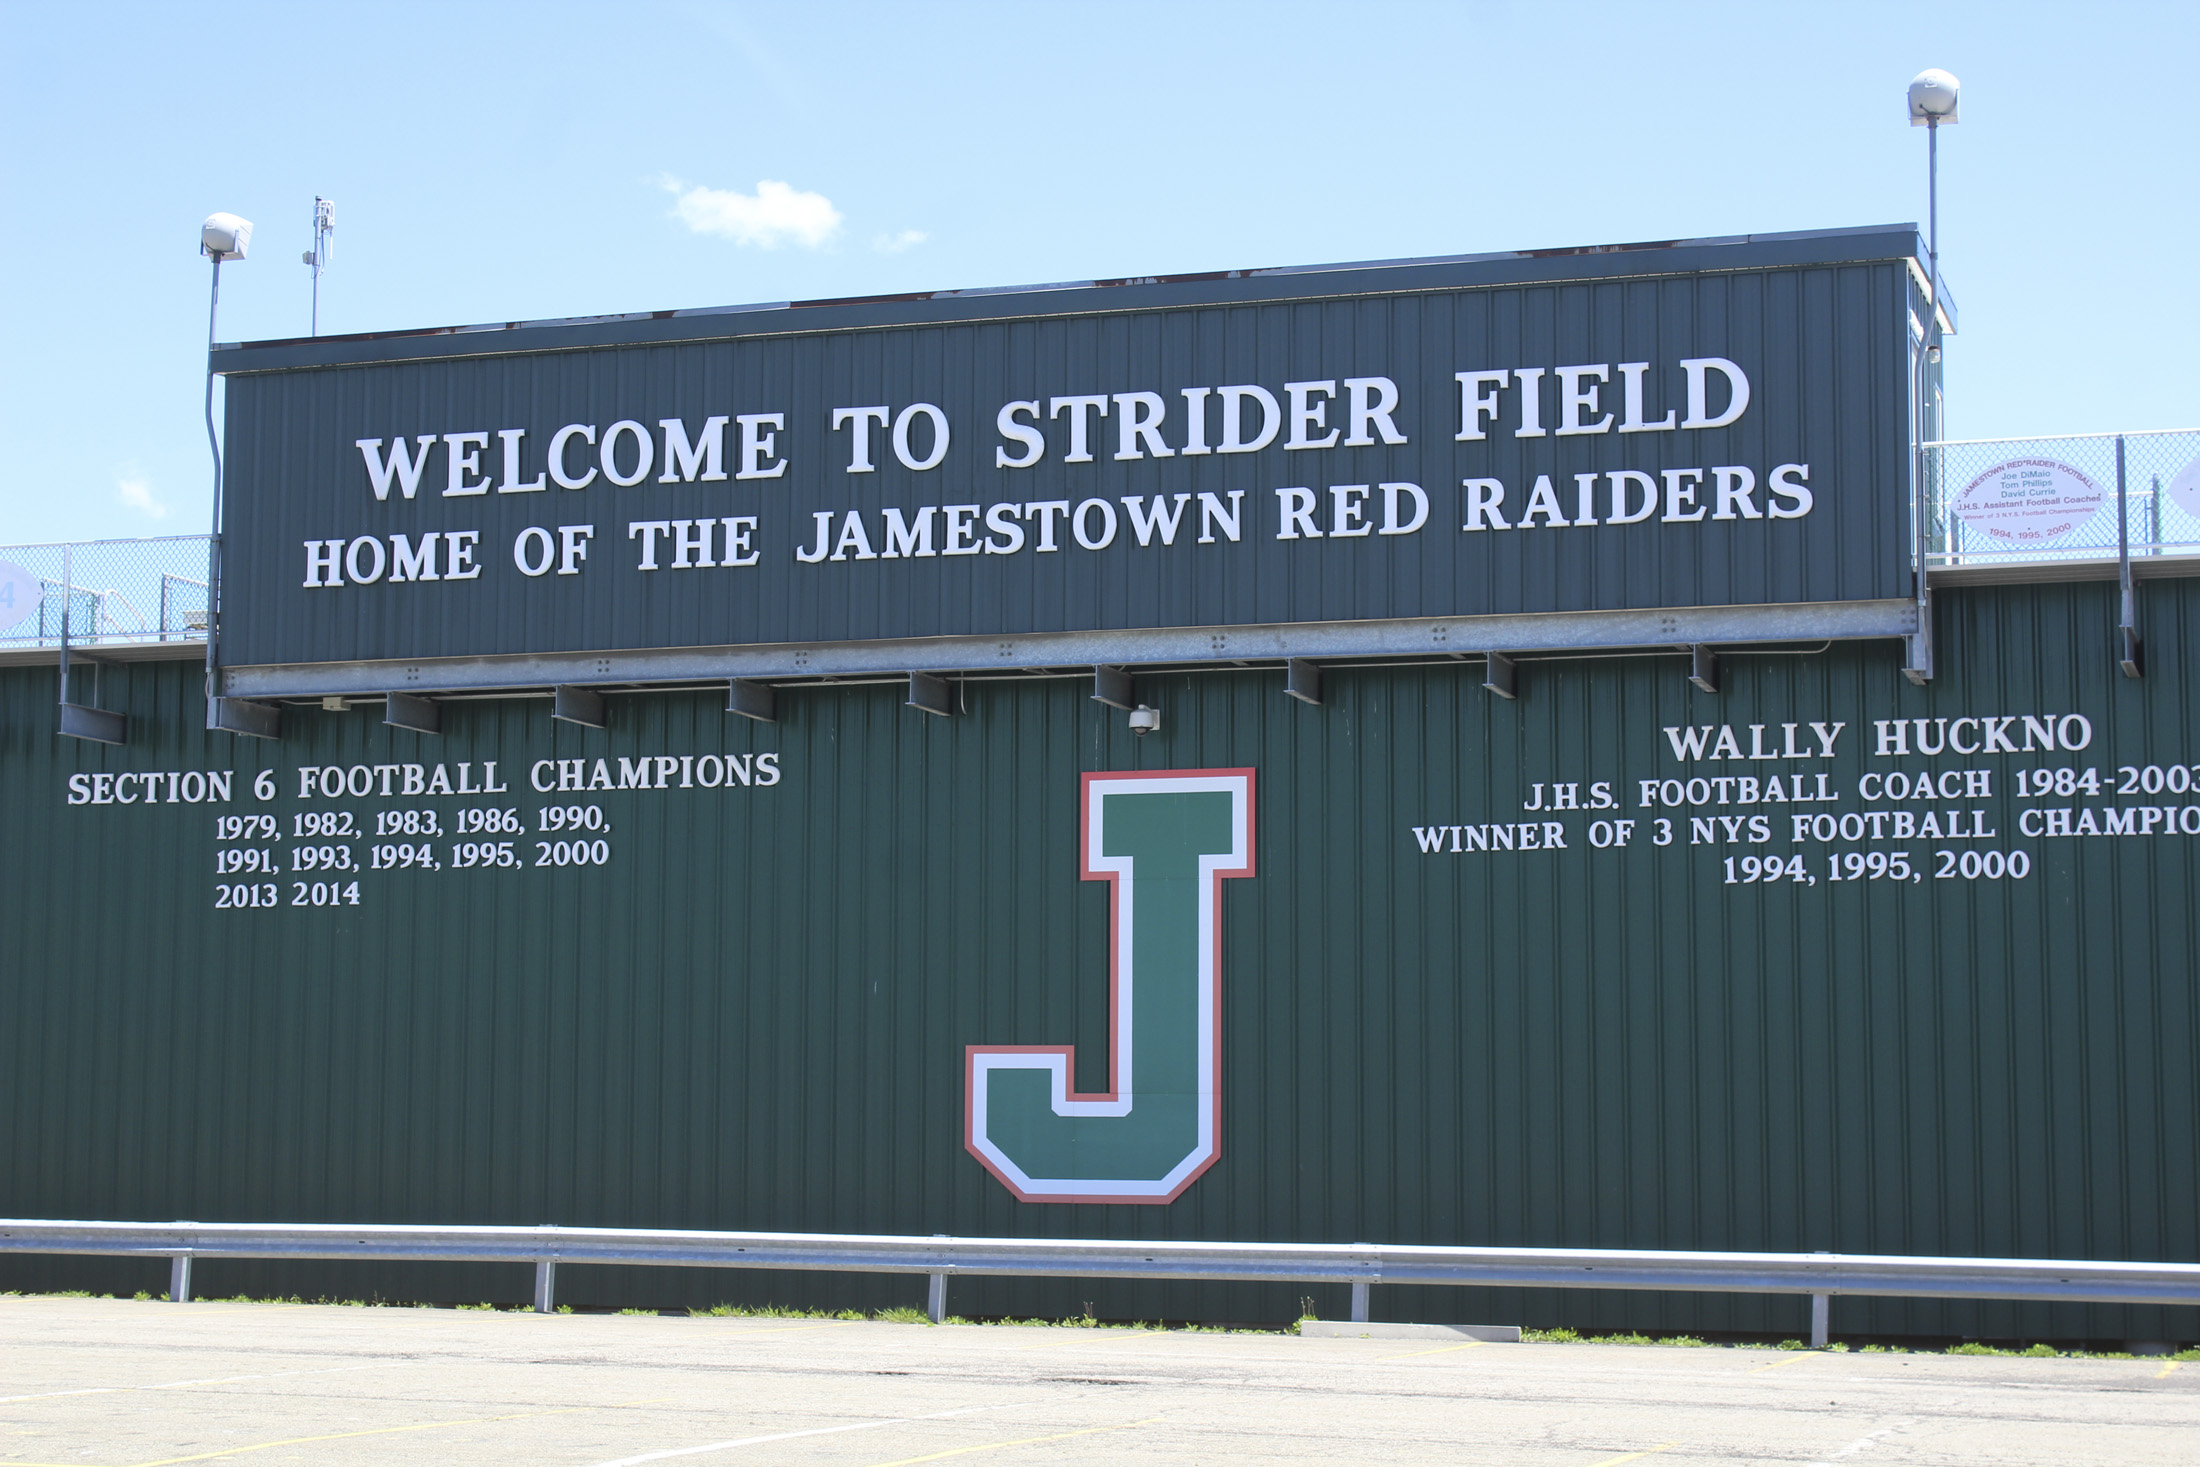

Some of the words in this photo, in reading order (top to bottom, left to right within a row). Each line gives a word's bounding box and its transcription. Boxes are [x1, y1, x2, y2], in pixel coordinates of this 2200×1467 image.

[356, 412, 788, 501] WELCOME
[832, 402, 950, 473] TO
[995, 376, 1408, 469] STRIDER
[1454, 357, 1750, 441] FIELD
[1963, 465, 2005, 498] JAMESTOWN
[2006, 460, 2023, 469] RED
[2026, 459, 2056, 468] RAIDER
[2057, 463, 2094, 490] FOOTBALL
[2000, 481, 2019, 489] Tom
[2022, 479, 2053, 488] Phillips
[2001, 472, 2017, 480] Joe
[2020, 470, 2051, 479] DiMaio
[2001, 490, 2026, 498] David
[2029, 488, 2056, 496] Currie
[1983, 500, 2023, 509] Assistant
[2026, 497, 2060, 506] Football
[2063, 495, 2101, 504] Coaches
[2048, 507, 2095, 515] Championships
[302, 530, 482, 588] HOME
[513, 524, 594, 577] OF
[628, 516, 761, 571] THE
[796, 489, 1245, 563] JAMESTOWN
[1275, 482, 1430, 540] RED
[1462, 463, 1813, 532] RAIDERS
[1990, 528, 2014, 540] 1994,
[2018, 531, 2043, 539] 1995,
[2046, 522, 2071, 536] 2000
[1662, 721, 1846, 762] WALLY
[1873, 714, 2092, 756] HUCKNO
[67, 770, 234, 805] SECTION
[254, 768, 276, 801] 6
[297, 761, 507, 799] FOOTBALL
[530, 752, 781, 793] CHAMPIONS
[1523, 781, 1620, 811] J.H.S.
[1638, 773, 1839, 808] FOOTBALL
[1858, 769, 1992, 801] COACH
[216, 814, 282, 842] 1979,
[293, 811, 362, 840] 1982,
[375, 809, 444, 838] 1983,
[456, 807, 526, 836] 1986,
[538, 805, 611, 834] 1990,
[1411, 821, 1568, 854] WINNER
[1588, 819, 1635, 848] OF
[1652, 818, 1673, 846] 3
[1689, 815, 1771, 845] NYS
[1790, 811, 1996, 843] FOOTBALL
[216, 848, 280, 876] 1991,
[291, 844, 360, 873] 1993,
[370, 843, 441, 872] 1994,
[451, 841, 523, 870] 1995,
[534, 839, 610, 867] 2000
[1723, 854, 1816, 887] 1994,
[1828, 851, 1921, 884] 1995,
[1934, 850, 2031, 880] 2000
[215, 883, 278, 909] 2013
[291, 881, 361, 907] 2014
[965, 767, 1256, 1205] J
